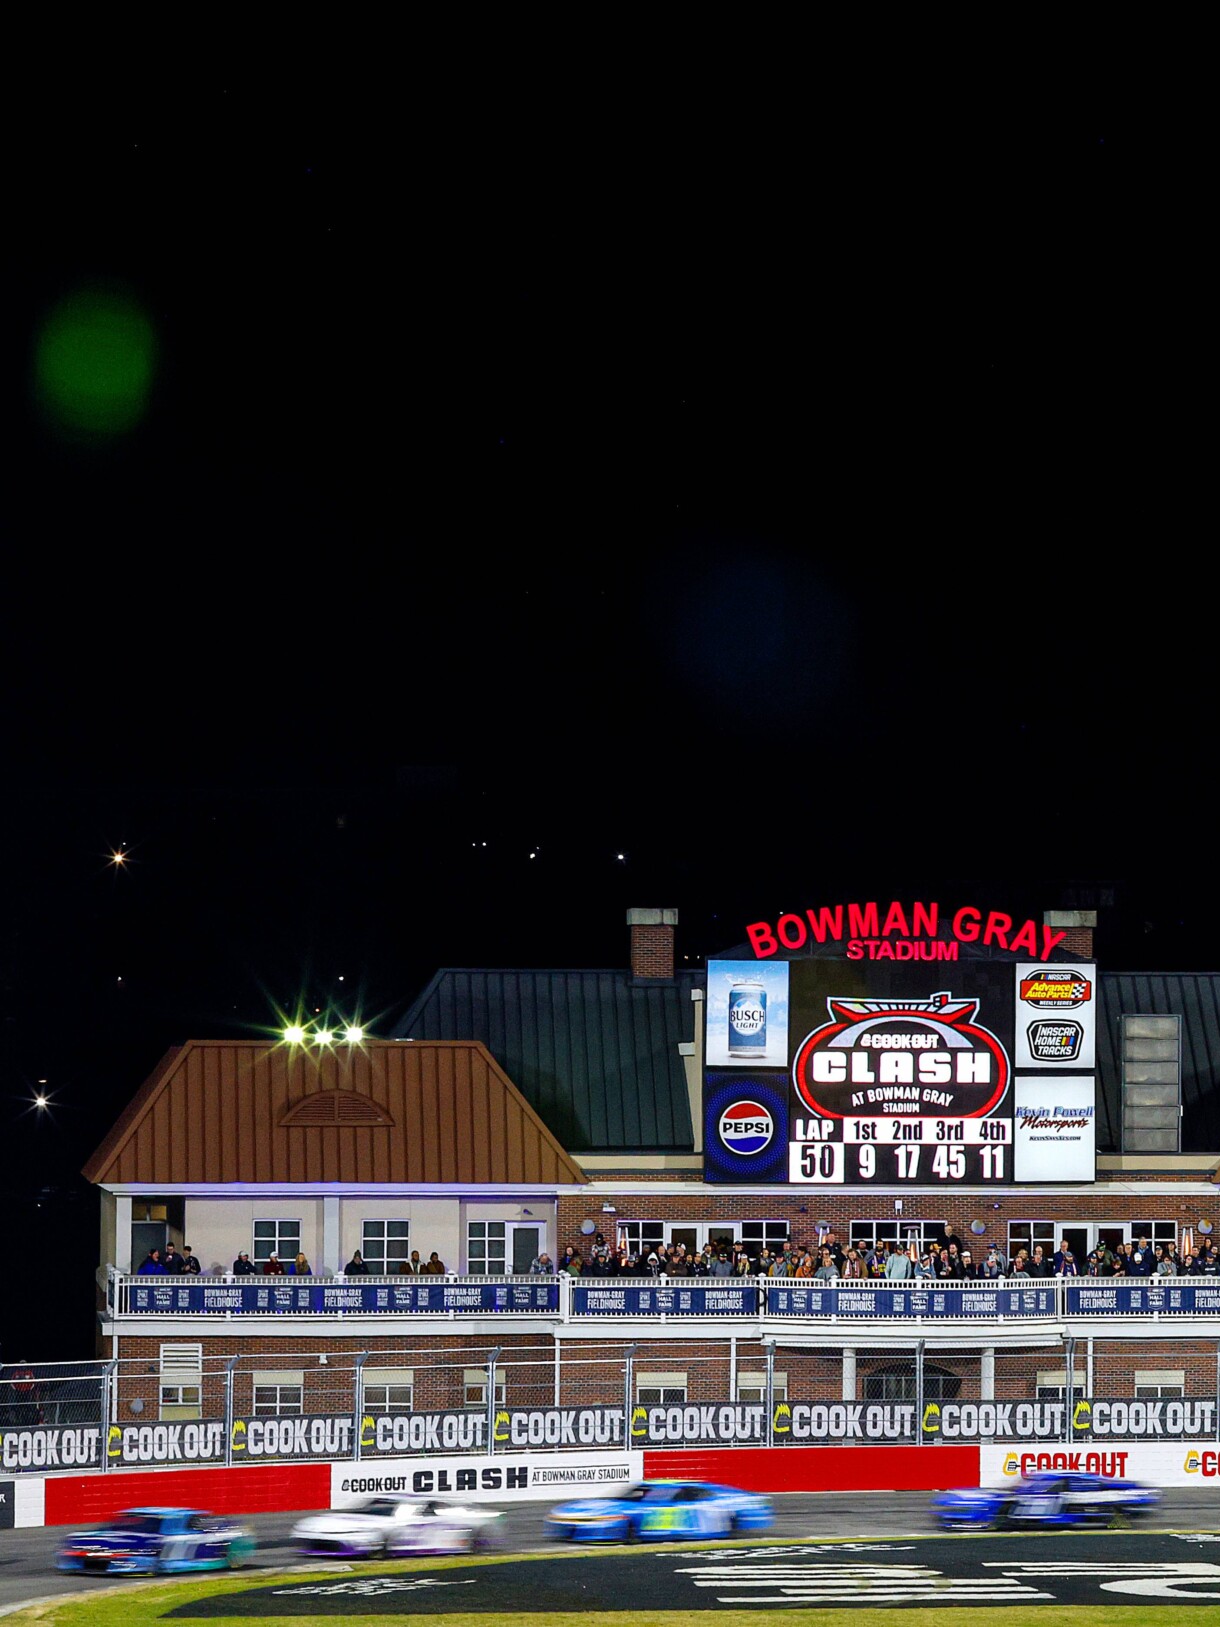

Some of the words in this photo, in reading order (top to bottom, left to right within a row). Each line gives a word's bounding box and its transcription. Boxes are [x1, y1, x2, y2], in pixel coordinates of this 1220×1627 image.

[746, 901, 939, 959] BOWMAN
[952, 906, 1067, 962] GRAY
[847, 939, 959, 961] STADIUM
[1031, 982, 1071, 992] Advance
[1025, 990, 1046, 998] Auto
[1046, 990, 1070, 998] Parts
[730, 1010, 765, 1022] BUSCH
[1040, 1027, 1076, 1036] NASCAR
[872, 1034, 912, 1049] COOK
[912, 1034, 939, 1049] OUT
[1034, 1036, 1062, 1046] HOME
[1038, 1046, 1073, 1056] TRACKS
[812, 1051, 991, 1083] CLASH
[852, 1093, 865, 1107] AT
[868, 1086, 920, 1102] BOWMAN
[922, 1088, 954, 1107] GRAY
[882, 1102, 920, 1113] STADIUM
[1015, 1106, 1051, 1118] Kevin
[1052, 1106, 1094, 1118] Powell
[722, 1122, 770, 1134] PEPSI
[795, 1119, 835, 1141] LAP
[853, 1120, 877, 1140] 1st
[892, 1120, 923, 1140] 2nd
[936, 1120, 964, 1140] 3rd
[979, 1120, 1006, 1140] 4th
[1019, 1115, 1090, 1133] Motorsports
[800, 1144, 835, 1179] 50
[858, 1144, 876, 1179] 9
[894, 1144, 921, 1179] 17
[932, 1144, 966, 1179] 45
[979, 1144, 1004, 1179] 11
[204, 1289, 242, 1297] BOWMAN-GRAY
[324, 1289, 362, 1297] BOWMAN-GRAY
[444, 1288, 481, 1296] BOWMAN-GRAY
[588, 1291, 624, 1299] BOWMAN-GRAY
[705, 1291, 742, 1299] BOWMAN-GRAY
[1080, 1290, 1116, 1298] BOWMAN-GRAY
[204, 1297, 242, 1307] FIELDHOUSE
[324, 1297, 362, 1307] FIELDHOUSE
[444, 1296, 482, 1306] FIELDHOUSE
[587, 1299, 625, 1309] FIELDHOUSE
[705, 1299, 743, 1310] FIELDHOUSE
[838, 1301, 876, 1312] FIELDHOUSE
[962, 1301, 997, 1312] FIELDHOUSE
[1080, 1298, 1117, 1309] FIELDHOUSE
[649, 1405, 716, 1440] COOK
[718, 1405, 764, 1439] OUT
[792, 1405, 863, 1438] COOK
[867, 1405, 915, 1437] OUT
[941, 1403, 1014, 1437] COOK
[1016, 1403, 1065, 1435] OUT
[1092, 1402, 1164, 1435] COOK
[1166, 1402, 1216, 1434] OUT
[376, 1415, 442, 1450] COOK
[443, 1414, 488, 1448] OUT
[512, 1410, 578, 1446] COOK
[579, 1409, 624, 1444] OUT
[123, 1425, 182, 1462] COOK
[183, 1422, 224, 1459] OUT
[249, 1420, 309, 1455] COOK
[309, 1418, 351, 1453] OUT
[3, 1429, 61, 1468] COOK
[62, 1427, 100, 1464] OUT
[1020, 1452, 1080, 1478] COOK
[1086, 1452, 1128, 1478] OUT
[350, 1477, 383, 1493] COOK
[384, 1476, 407, 1491] OUT
[412, 1466, 528, 1493] CLASH
[532, 1472, 540, 1482] AT
[542, 1470, 576, 1482] BOWMAN
[577, 1470, 596, 1480] GRAY
[598, 1468, 630, 1480] STADIUM
